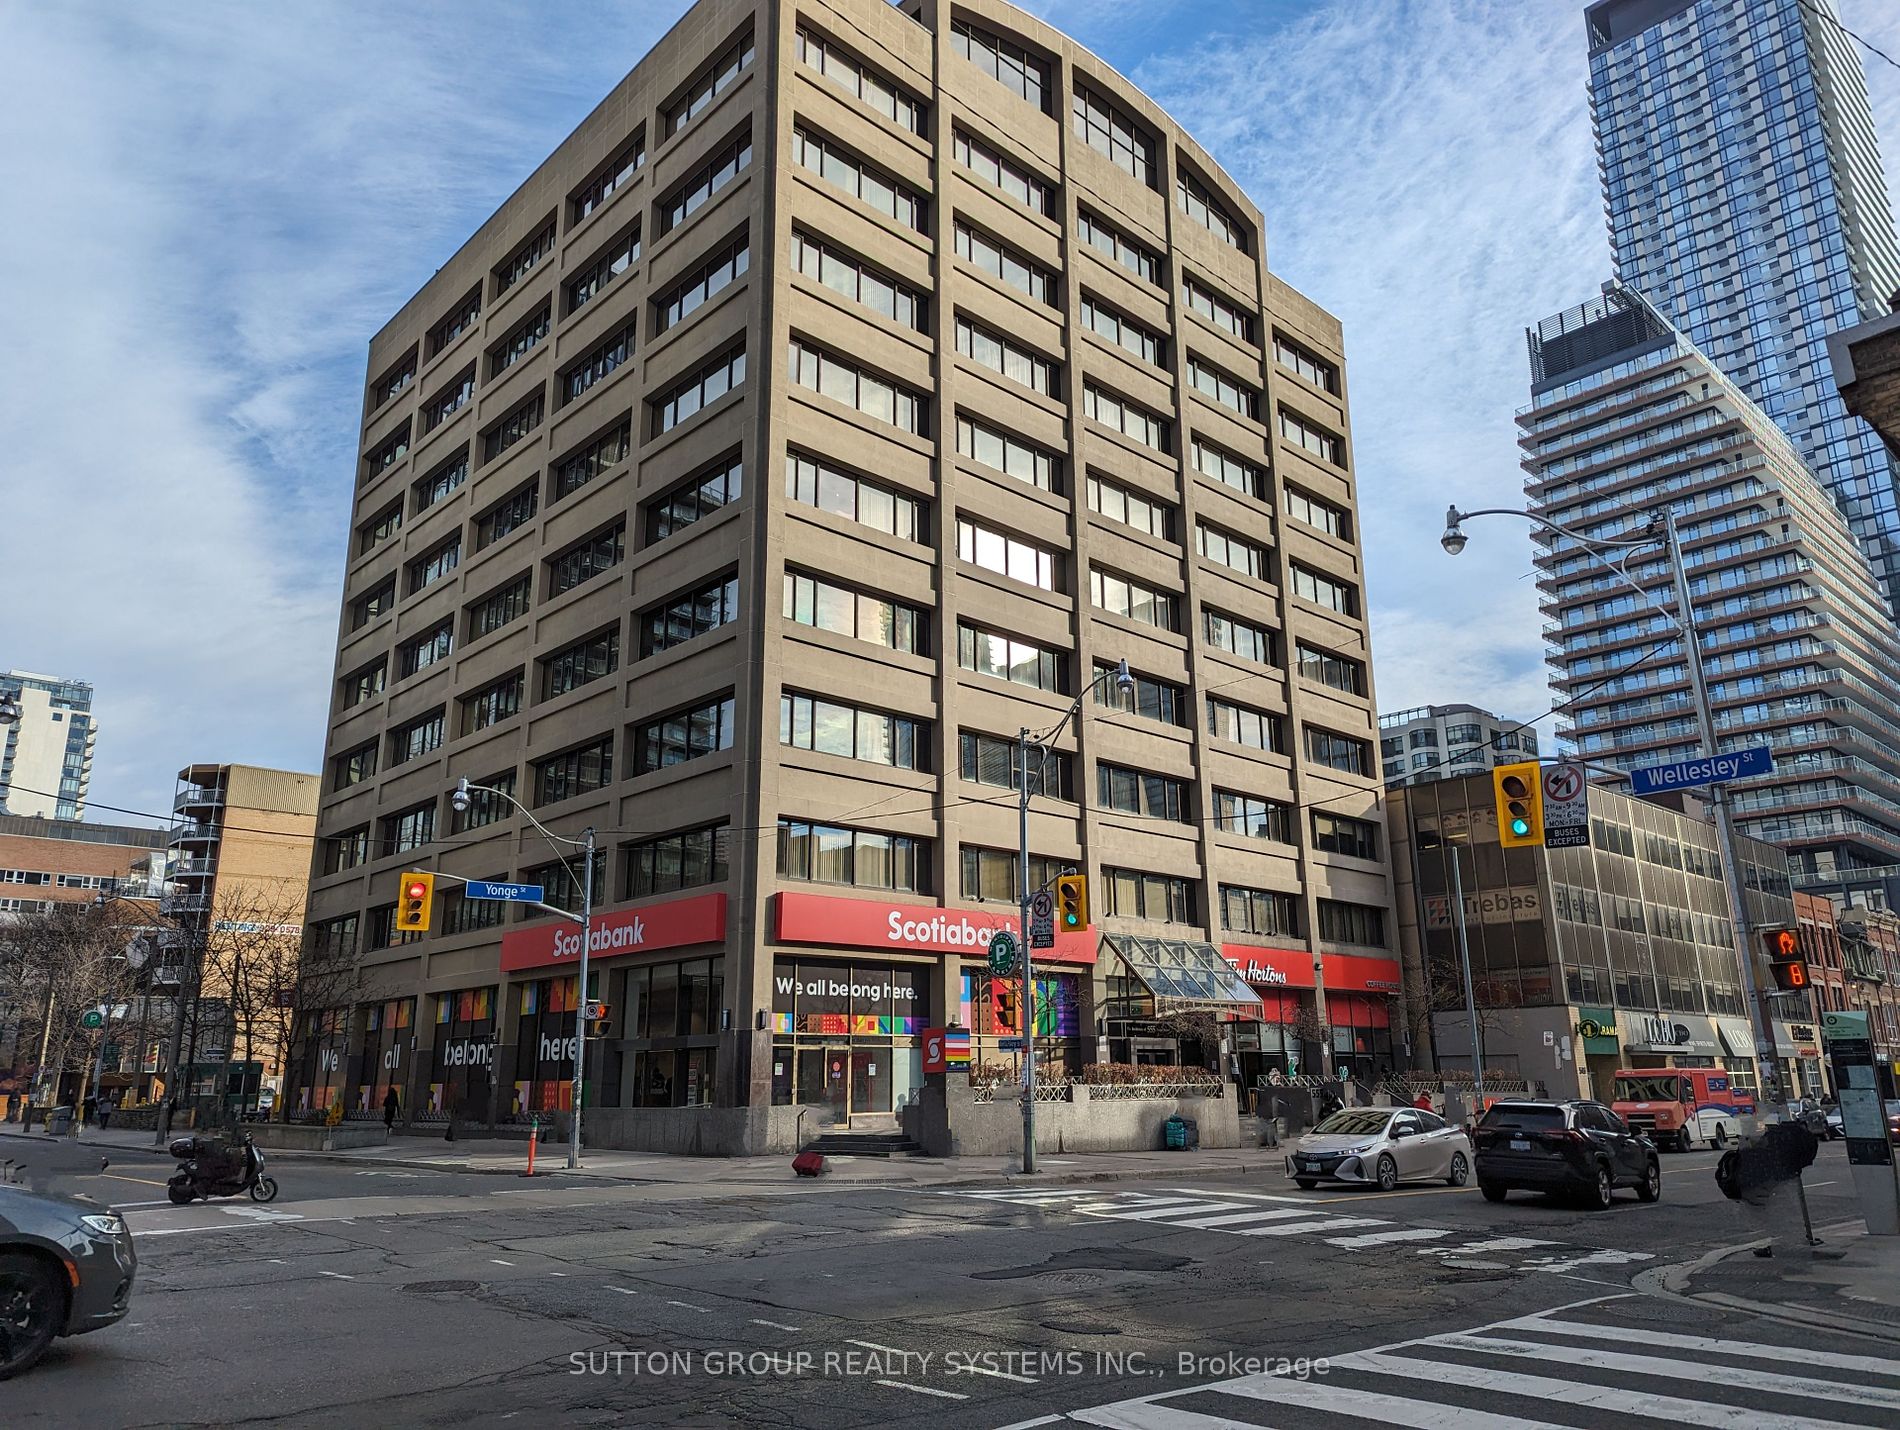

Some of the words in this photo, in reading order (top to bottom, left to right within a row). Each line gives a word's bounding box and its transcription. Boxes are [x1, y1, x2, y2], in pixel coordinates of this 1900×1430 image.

[1647, 758, 1739, 787] Wellesley
[1742, 752, 1754, 763] St
[1548, 836, 1587, 846] EXCEPTED
[1554, 828, 1580, 837] BUSES
[486, 884, 518, 899] Yonge
[1463, 893, 1537, 914] Trebas
[553, 916, 645, 957] Scoabank
[888, 911, 1019, 948] Scotiaba
[995, 943, 1007, 962] P
[1247, 958, 1287, 984] Hortons
[1790, 964, 1803, 985] 8
[776, 977, 803, 995] We
[806, 979, 825, 996] all
[1646, 1017, 1676, 1043] LCBO
[322, 1049, 338, 1071] We
[384, 1044, 400, 1069] all
